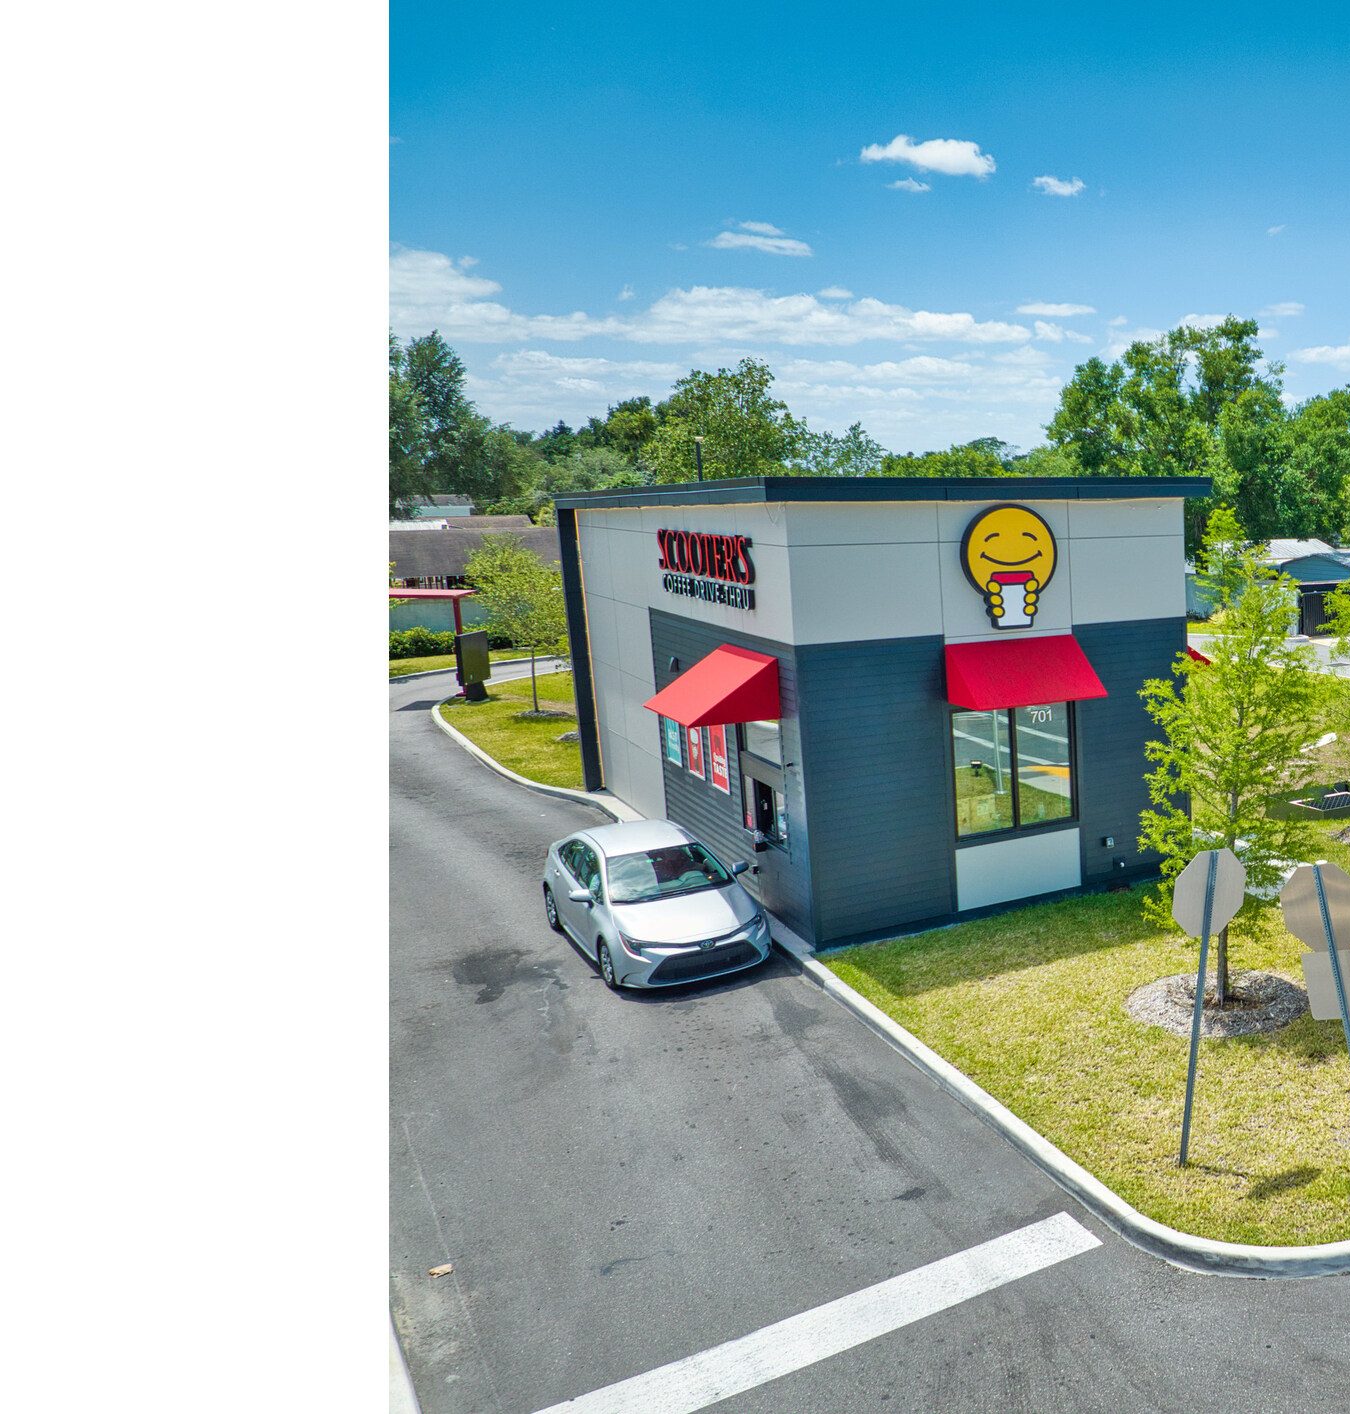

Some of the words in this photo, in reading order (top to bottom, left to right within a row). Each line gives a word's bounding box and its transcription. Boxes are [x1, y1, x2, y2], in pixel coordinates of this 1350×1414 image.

[657, 528, 755, 585] SCOOTER'S
[663, 573, 692, 598] COFFEE
[1030, 708, 1053, 724] 701
